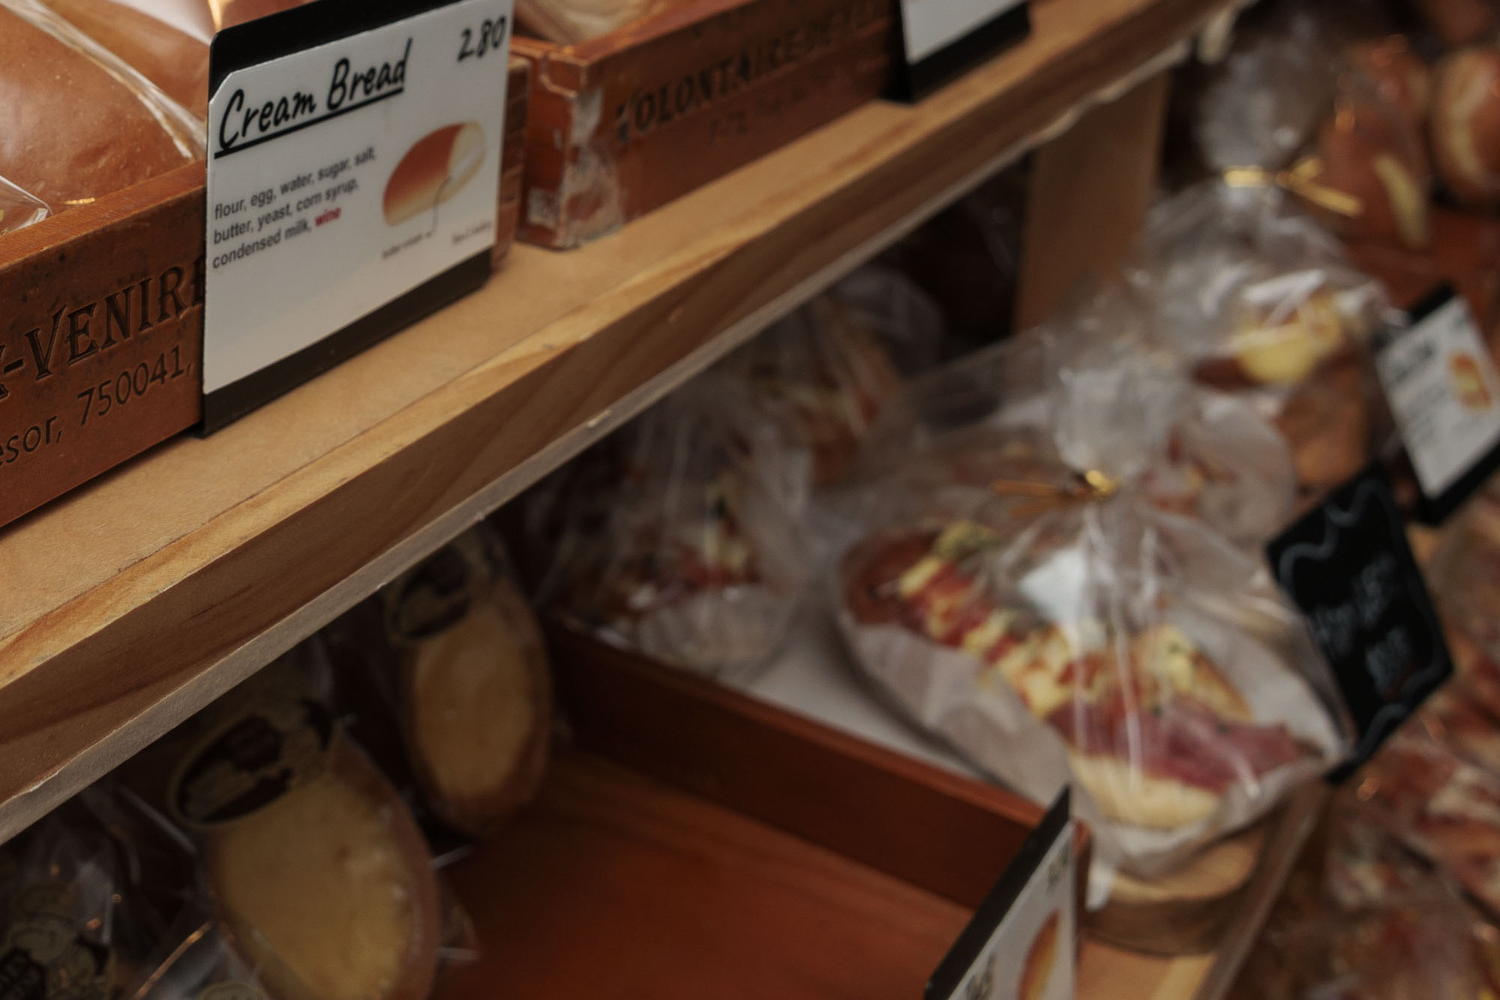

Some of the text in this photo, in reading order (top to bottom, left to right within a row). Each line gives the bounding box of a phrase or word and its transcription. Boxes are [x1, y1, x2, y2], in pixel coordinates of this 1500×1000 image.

[218, 36, 413, 150] Cream Bread
[213, 219, 254, 246] butter,
[257, 203, 293, 232] yeast,
[296, 191, 323, 213] corn
[214, 199, 247, 221] flour,
[250, 188, 276, 208] egg,
[280, 173, 315, 196] water,
[318, 159, 351, 181] sugar,
[212, 206, 342, 269] condensed milk, wine
[77, 344, 192, 426] 750041,
